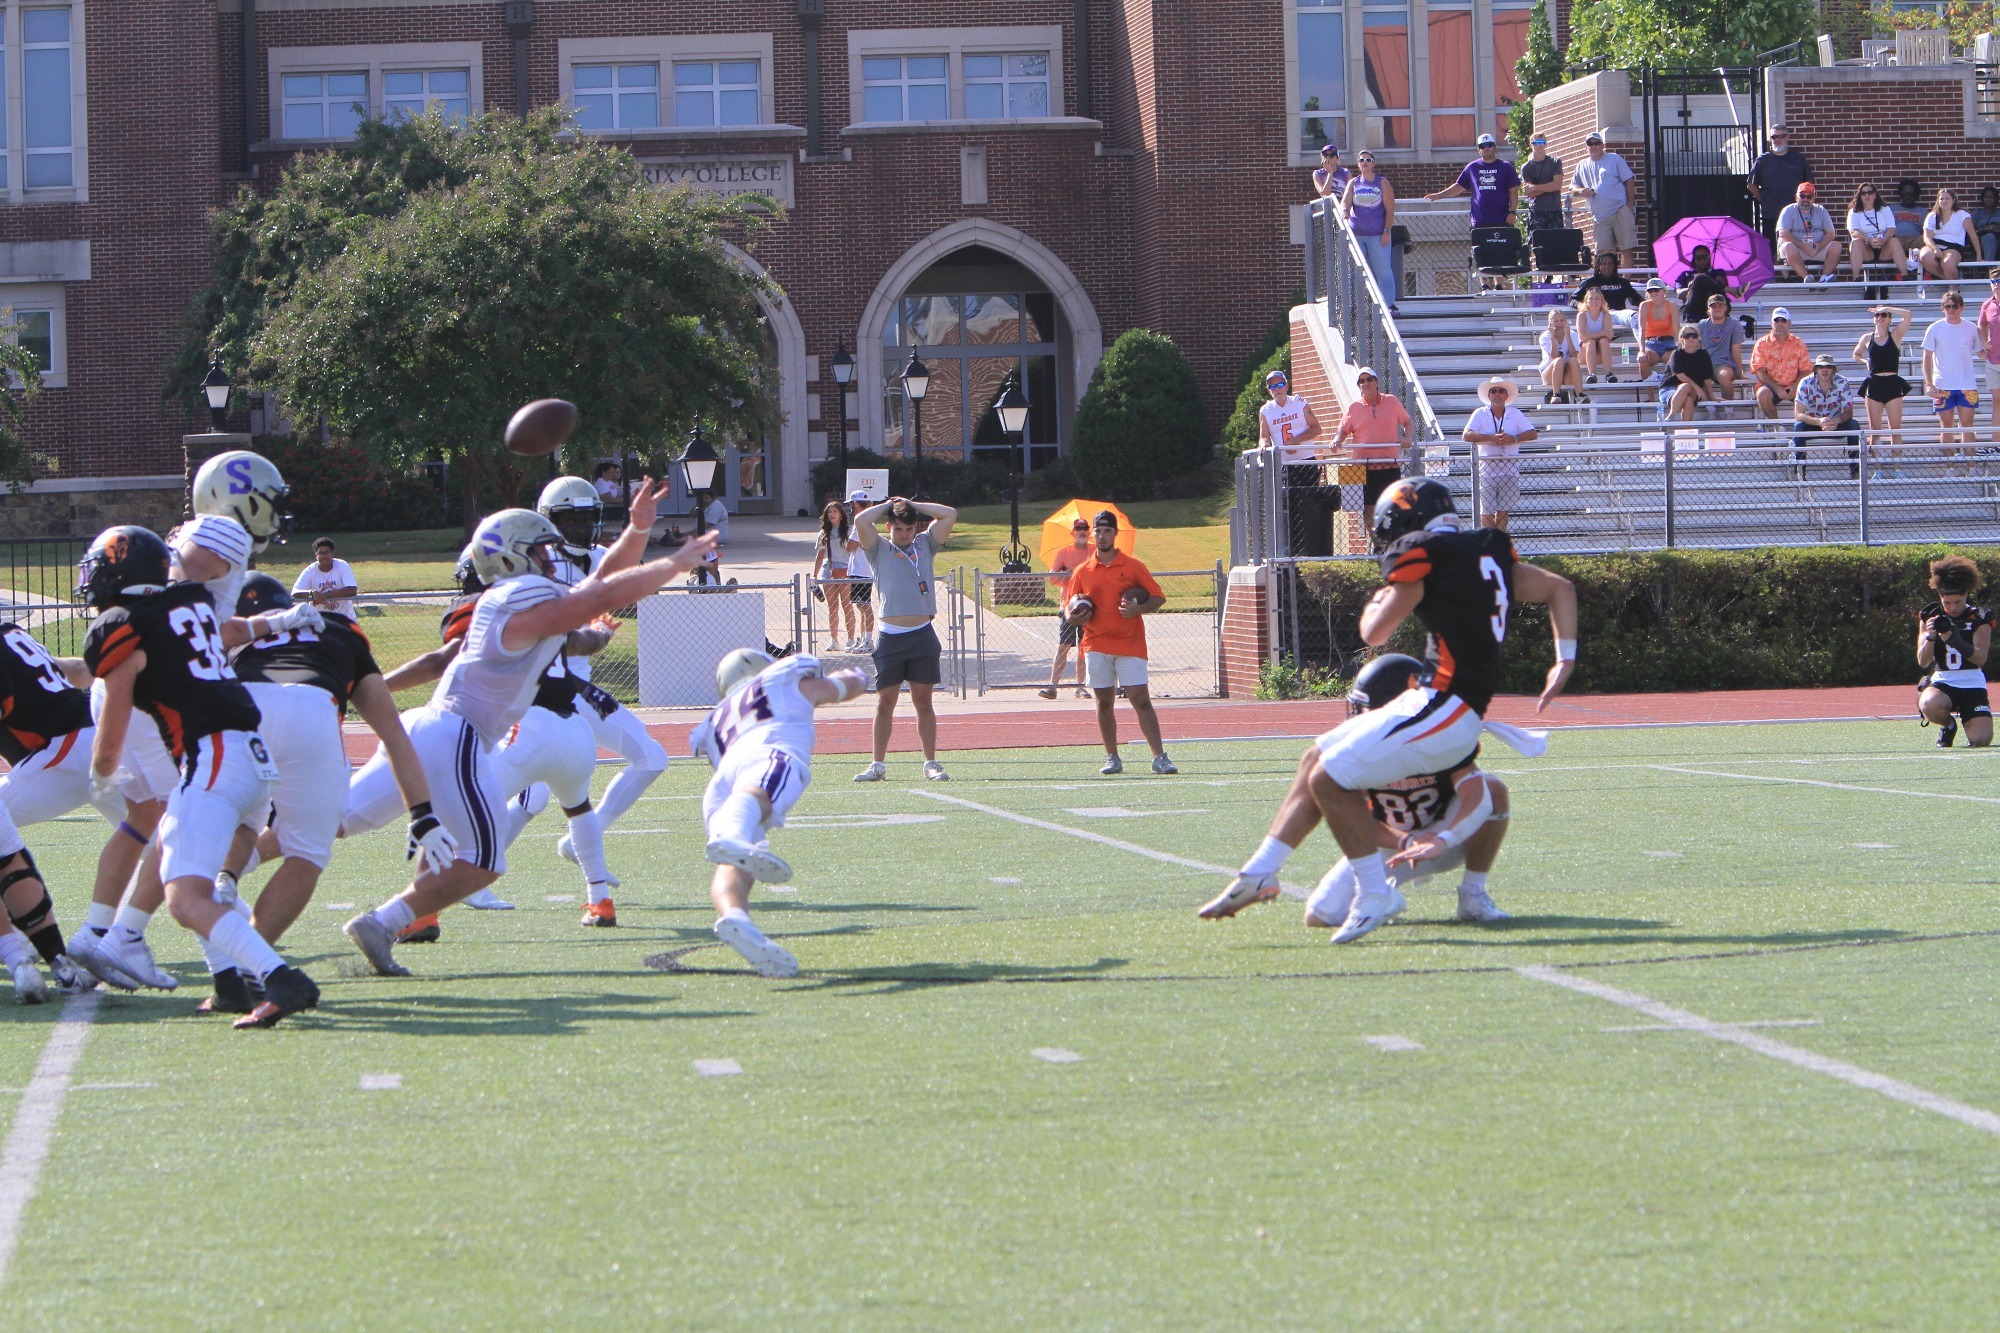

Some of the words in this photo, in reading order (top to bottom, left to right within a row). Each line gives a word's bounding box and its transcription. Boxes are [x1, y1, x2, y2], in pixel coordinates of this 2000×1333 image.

[642, 169, 675, 184] RIX
[681, 165, 781, 183] COLLEGE
[226, 459, 252, 495] S
[861, 478, 876, 486] EXIT
[1479, 555, 1509, 643] 3
[1376, 788, 1440, 831] 82
